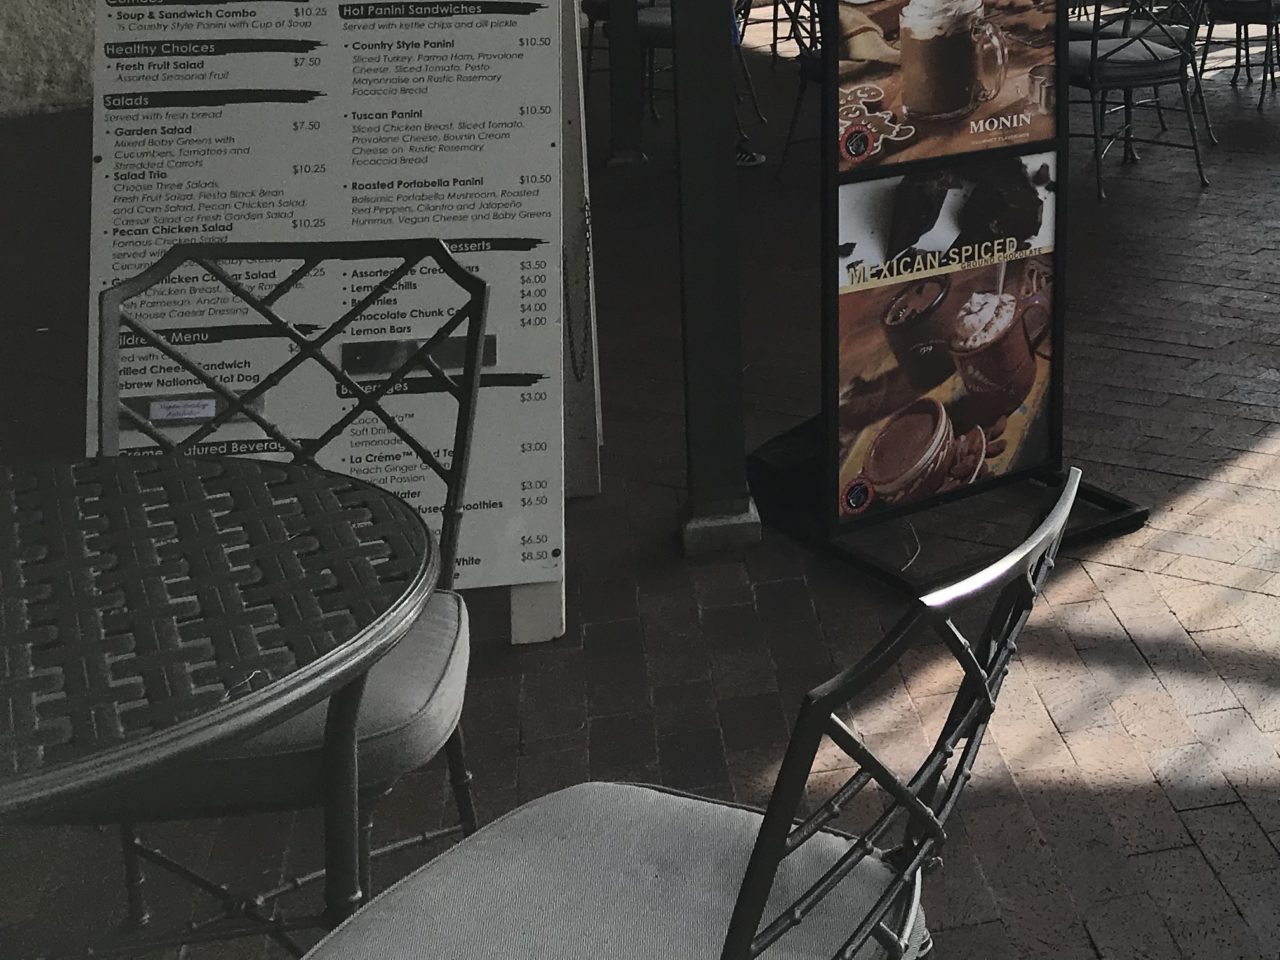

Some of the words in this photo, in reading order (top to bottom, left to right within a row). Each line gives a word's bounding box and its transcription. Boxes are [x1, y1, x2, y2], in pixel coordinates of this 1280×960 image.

[116, 10, 144, 21] Soup
[147, 10, 155, 20] &
[159, 10, 213, 19] Sandwich
[215, 9, 257, 18] Combo
[343, 6, 364, 16] Hot
[368, 5, 405, 15] Panini
[409, 4, 482, 15] Sandwiches
[352, 41, 393, 51] Country
[396, 41, 421, 50] Style
[424, 40, 455, 49] Panini
[518, 37, 551, 47] $10.50
[106, 45, 157, 56] Healthy
[161, 43, 215, 54] Choices
[116, 62, 144, 72] Fresh
[147, 61, 171, 70] Fruit
[173, 61, 204, 70] Salad
[104, 96, 149, 107] Salads
[352, 110, 388, 120] Tuscan
[391, 109, 423, 119] Panini
[519, 106, 551, 115] $10.50
[969, 112, 1032, 135] MONIN
[115, 127, 157, 137] Garden
[161, 125, 192, 135] Salad
[113, 171, 146, 181] Salad
[149, 170, 167, 180] Trio
[519, 175, 552, 184] $10.50
[352, 180, 394, 190] Roasted
[397, 179, 450, 189] Portabella
[453, 177, 483, 187] Panini
[112, 227, 149, 236] Pecan
[152, 225, 199, 235] Chicken
[202, 223, 233, 233] Salad
[447, 241, 491, 252] esserts
[960, 256, 997, 270] GROUND
[998, 247, 1043, 264] CHOCOLATE
[520, 260, 547, 270] $3.50
[245, 271, 276, 280] Salad
[520, 275, 547, 284] $6.00
[410, 309, 444, 318] Chunk
[351, 326, 387, 336] Lemon
[390, 325, 412, 334] Bars
[171, 332, 209, 342] Menu
[119, 366, 147, 375] rilled
[521, 443, 547, 452] $3.00
[350, 455, 362, 464] La
